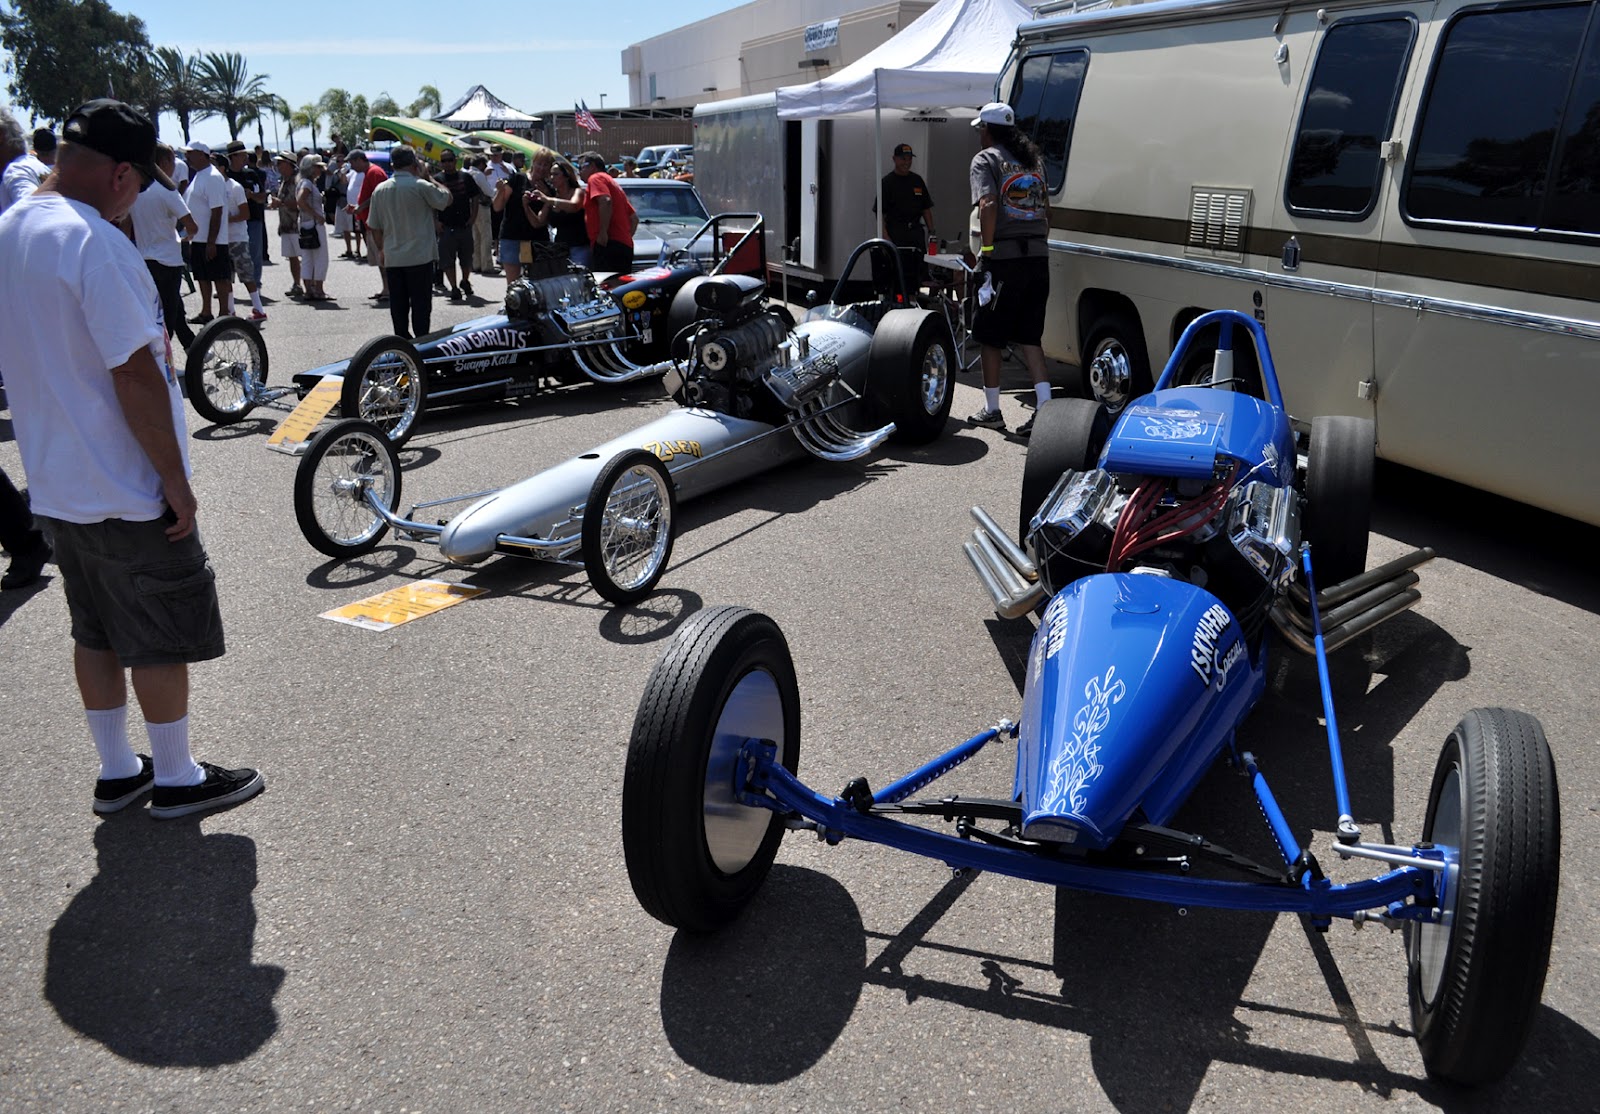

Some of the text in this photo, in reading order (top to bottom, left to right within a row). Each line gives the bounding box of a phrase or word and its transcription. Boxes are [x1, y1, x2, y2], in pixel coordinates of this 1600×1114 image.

[442, 119, 532, 130] every part for power
[436, 336, 472, 357] DON
[454, 359, 491, 373] Swamp
